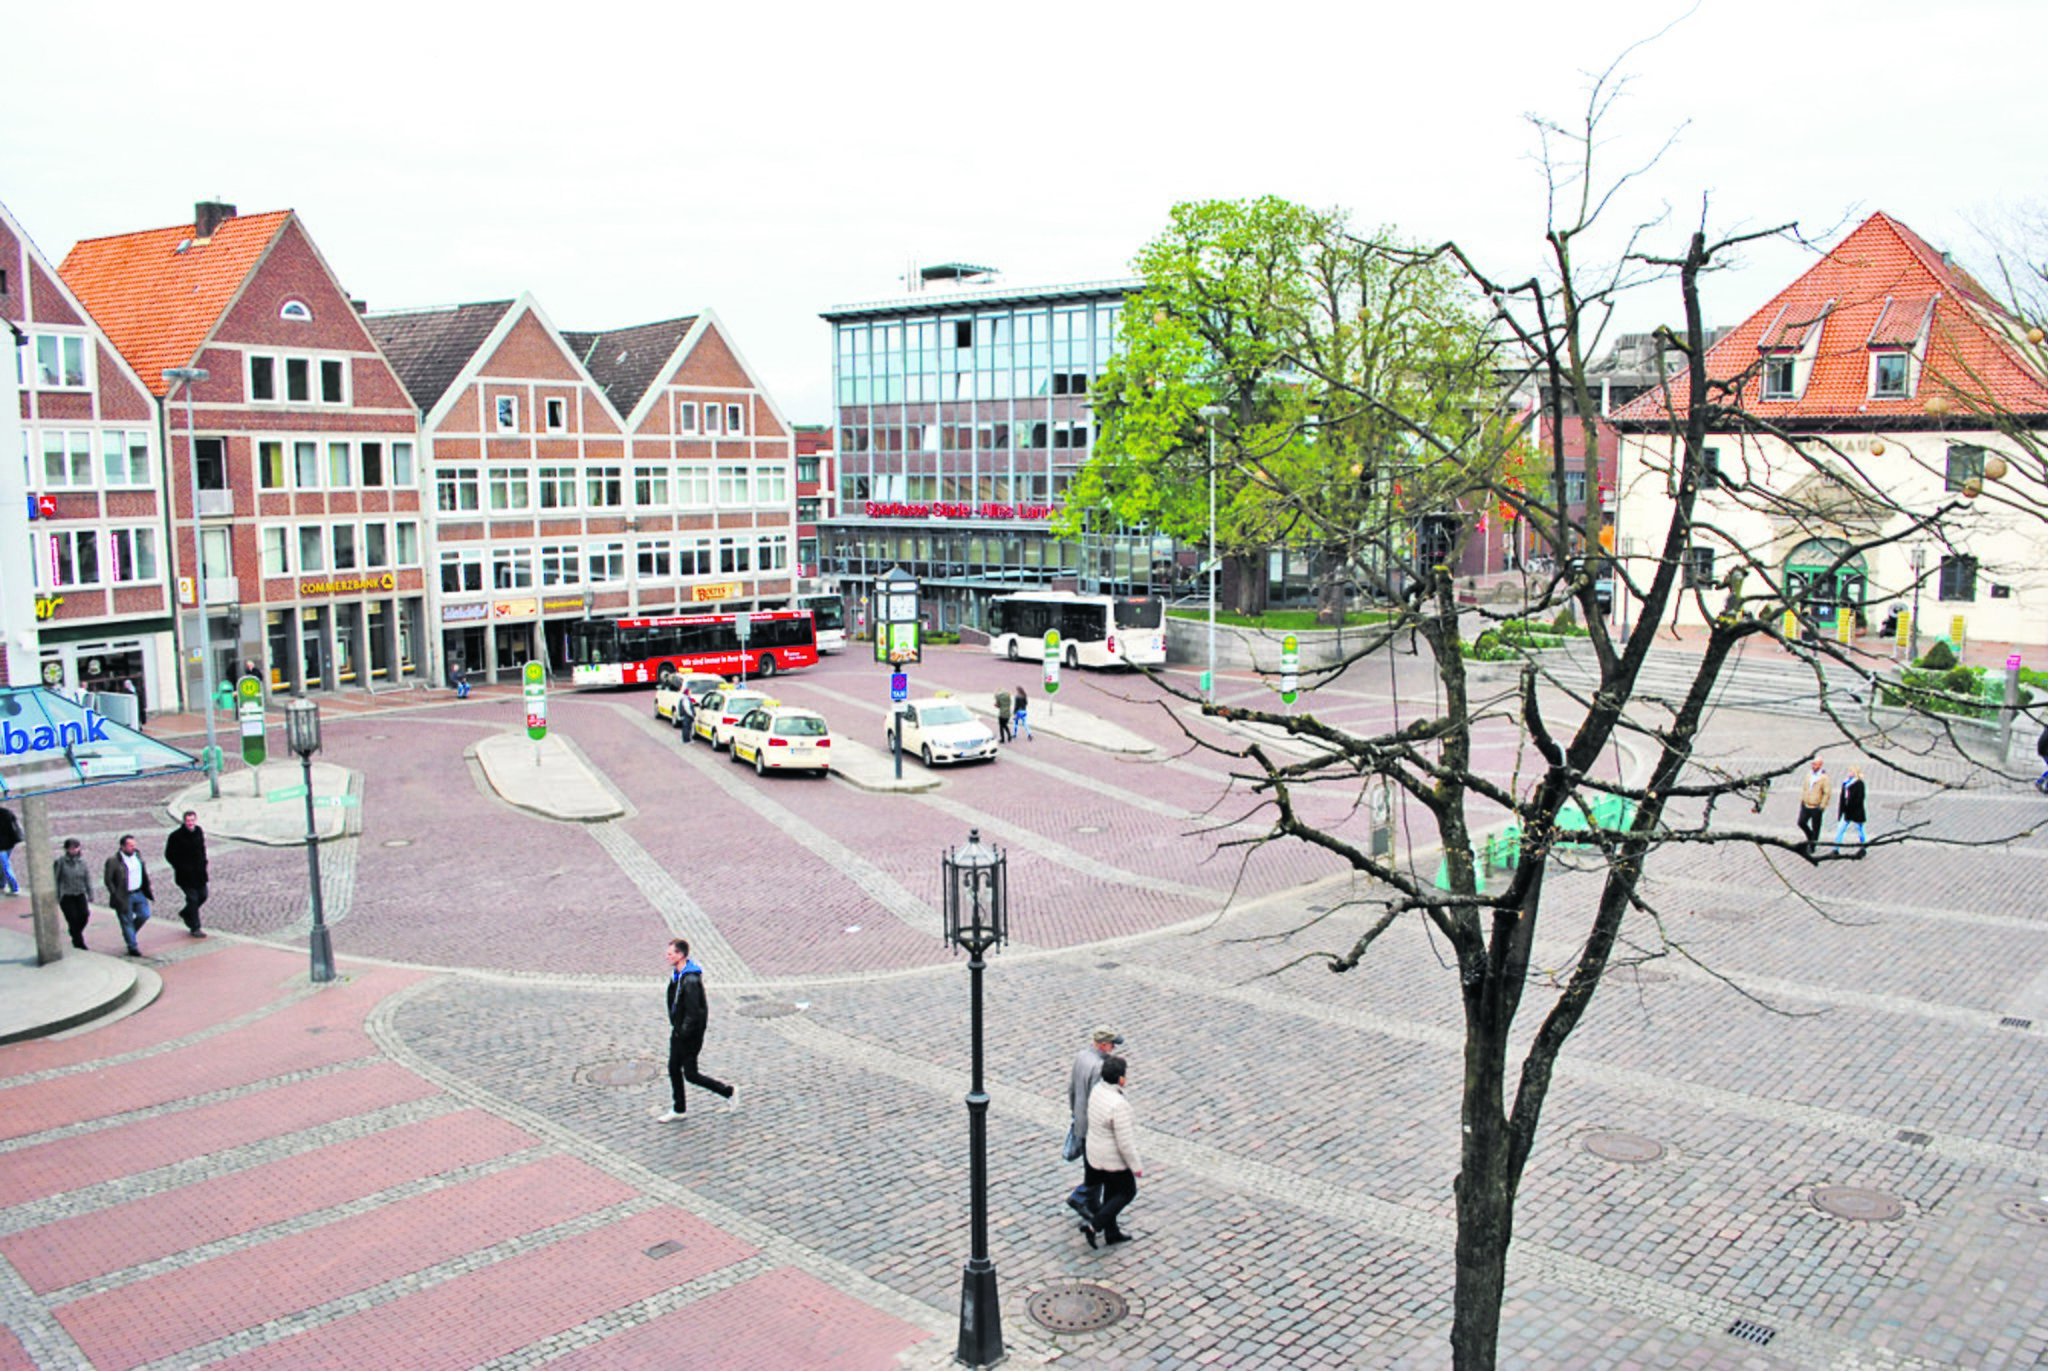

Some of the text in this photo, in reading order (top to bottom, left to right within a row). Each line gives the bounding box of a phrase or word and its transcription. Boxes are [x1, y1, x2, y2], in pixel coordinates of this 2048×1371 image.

[865, 501, 929, 519] Sparkasse
[932, 502, 970, 517] Stade
[980, 503, 1014, 518] Altes
[301, 578, 379, 594] COMMERZBANK
[893, 690, 906, 698] TAXI
[0, 709, 109, 755] bank
